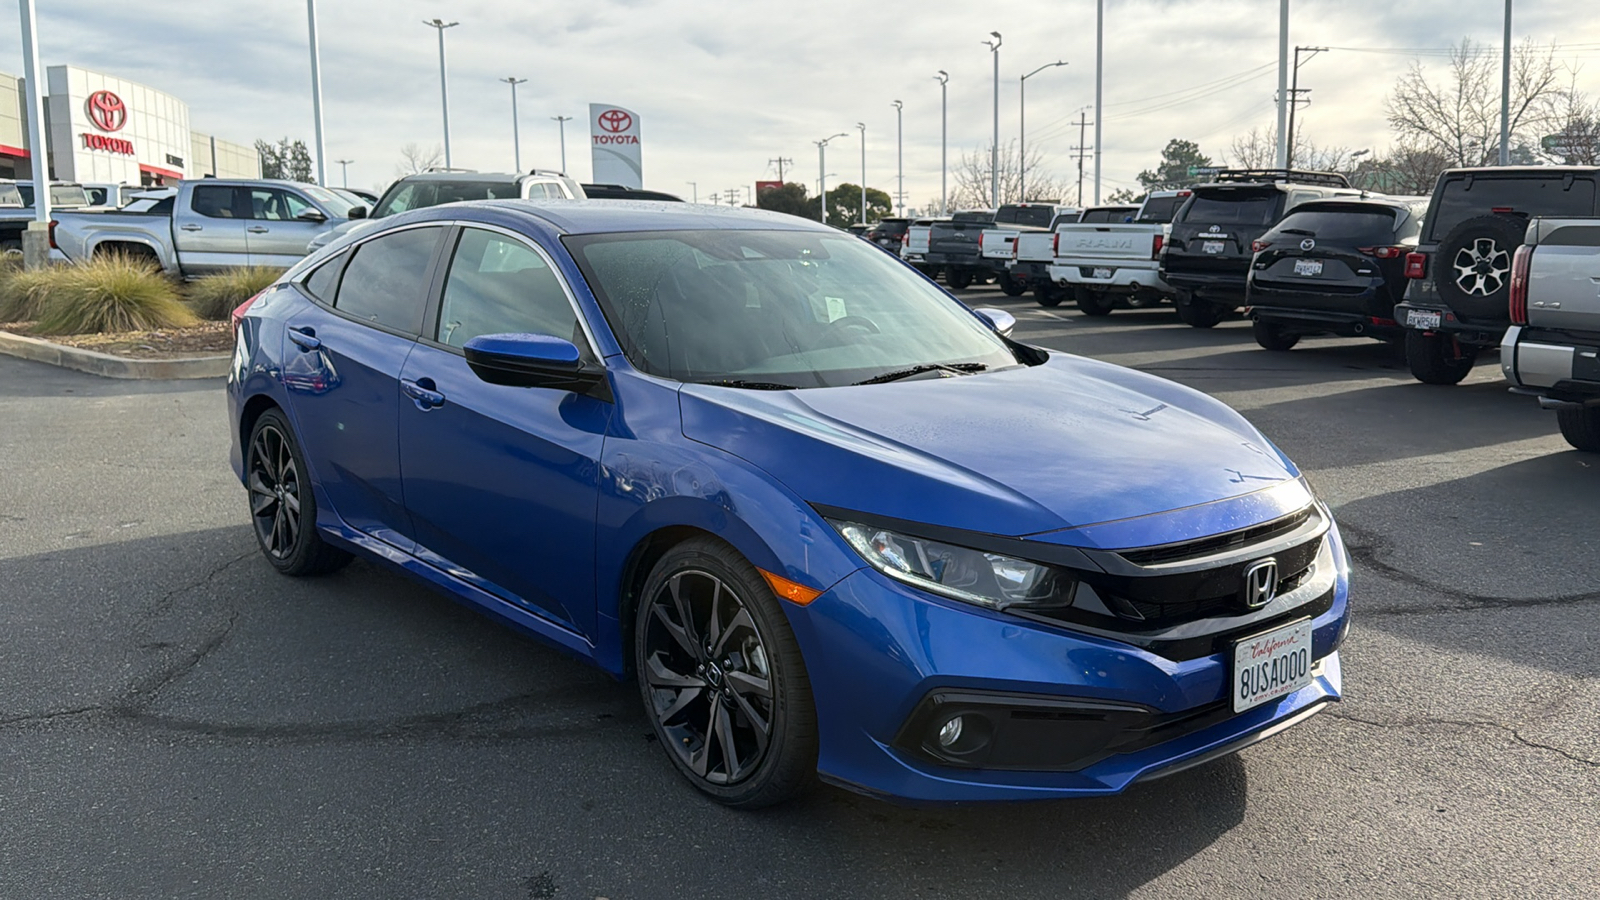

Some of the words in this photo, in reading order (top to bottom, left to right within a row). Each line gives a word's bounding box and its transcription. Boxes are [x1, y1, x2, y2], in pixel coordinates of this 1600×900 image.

[82, 132, 135, 155] TOYOTA
[592, 134, 639, 145] TOYOTA
[1076, 238, 1133, 249] RAM
[1252, 636, 1299, 659] California
[1241, 648, 1307, 700] 8USA000
[1253, 683, 1293, 702] dmv.ca.gov
